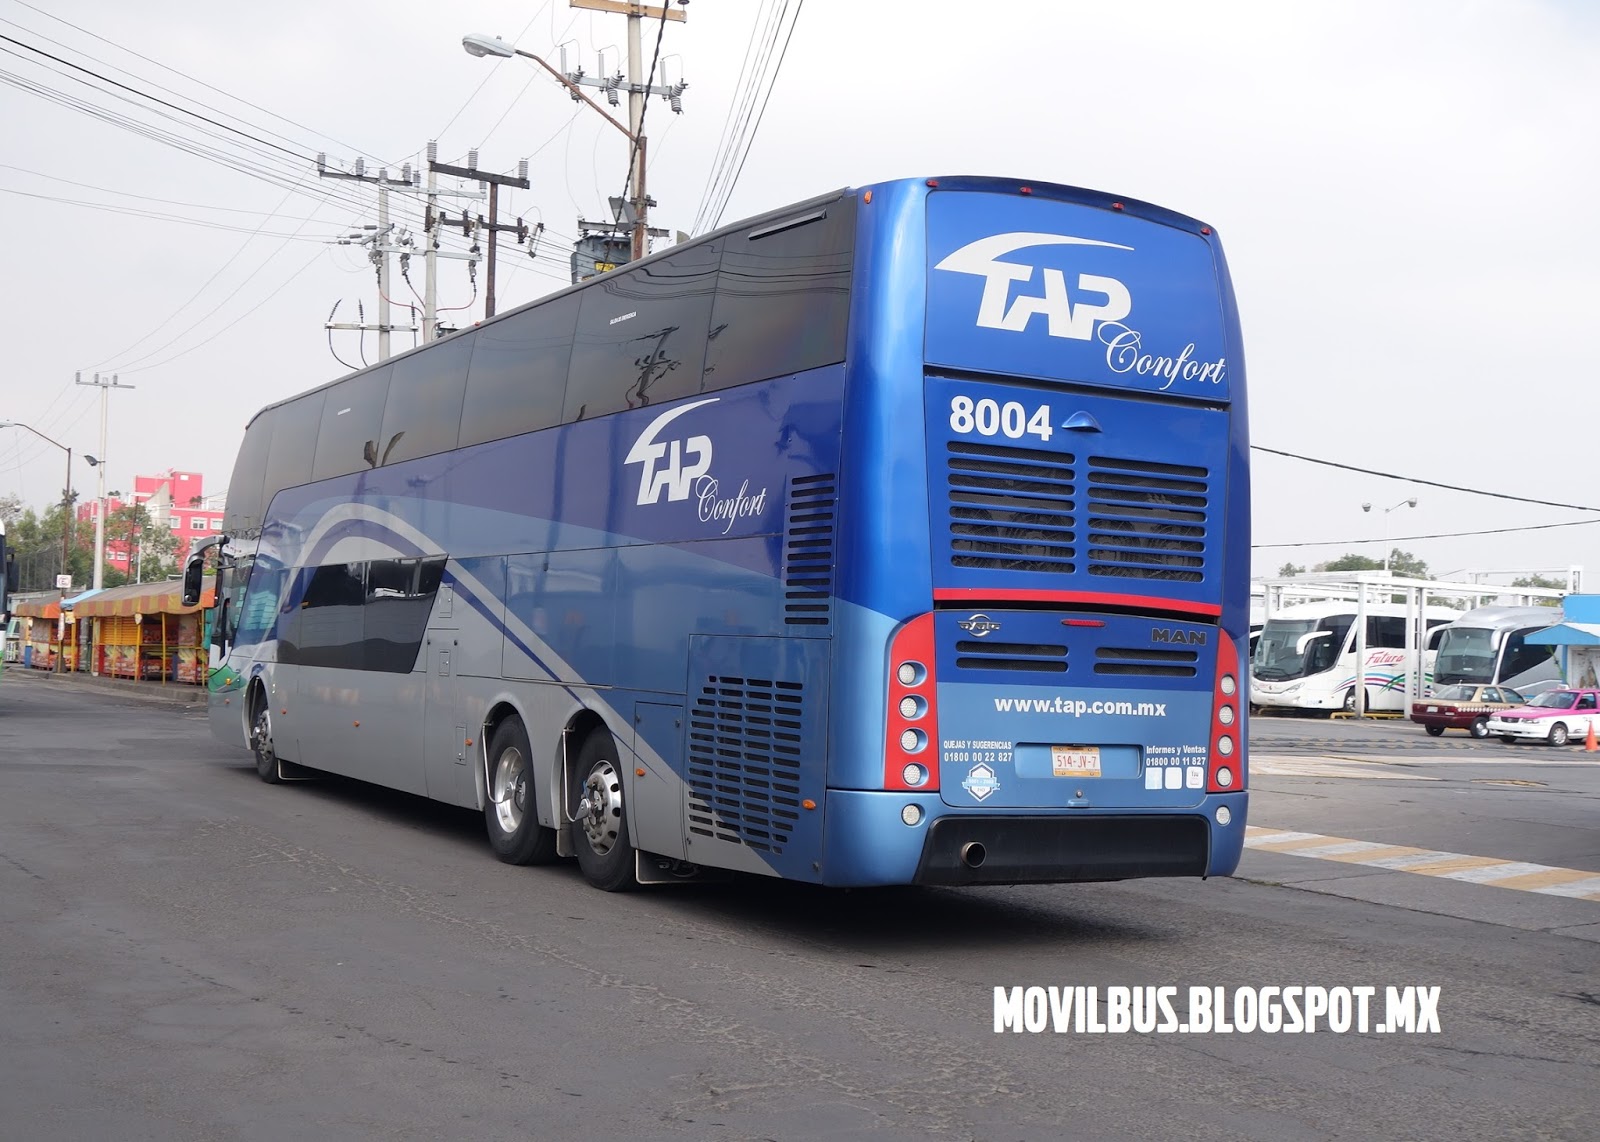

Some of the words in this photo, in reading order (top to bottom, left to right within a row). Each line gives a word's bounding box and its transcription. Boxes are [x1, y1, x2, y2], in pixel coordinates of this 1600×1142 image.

[934, 232, 1135, 341] TAP
[1097, 320, 1226, 391] Confort
[949, 395, 1053, 442] 8004
[624, 397, 720, 506] TAP
[695, 474, 767, 535] Confort
[1152, 627, 1207, 646] MAN
[1364, 650, 1406, 666] Futura
[994, 696, 1166, 717] www.tap.com.mx
[943, 740, 966, 749] QUEJAS
[966, 740, 972, 749] Y
[972, 741, 1012, 750] SUGERENCIAS
[1146, 745, 1176, 754] Informes
[1176, 747, 1182, 756] y
[1182, 745, 1206, 754] Ventas
[944, 752, 969, 762] 01800
[972, 752, 983, 762] 00
[984, 752, 995, 762] 22
[998, 752, 1013, 762] 827
[1056, 755, 1097, 768] 514-JV-7
[1145, 757, 1169, 766] 01800
[1170, 757, 1180, 766] 00
[1182, 757, 1190, 766] 11
[1191, 757, 1207, 766] 827
